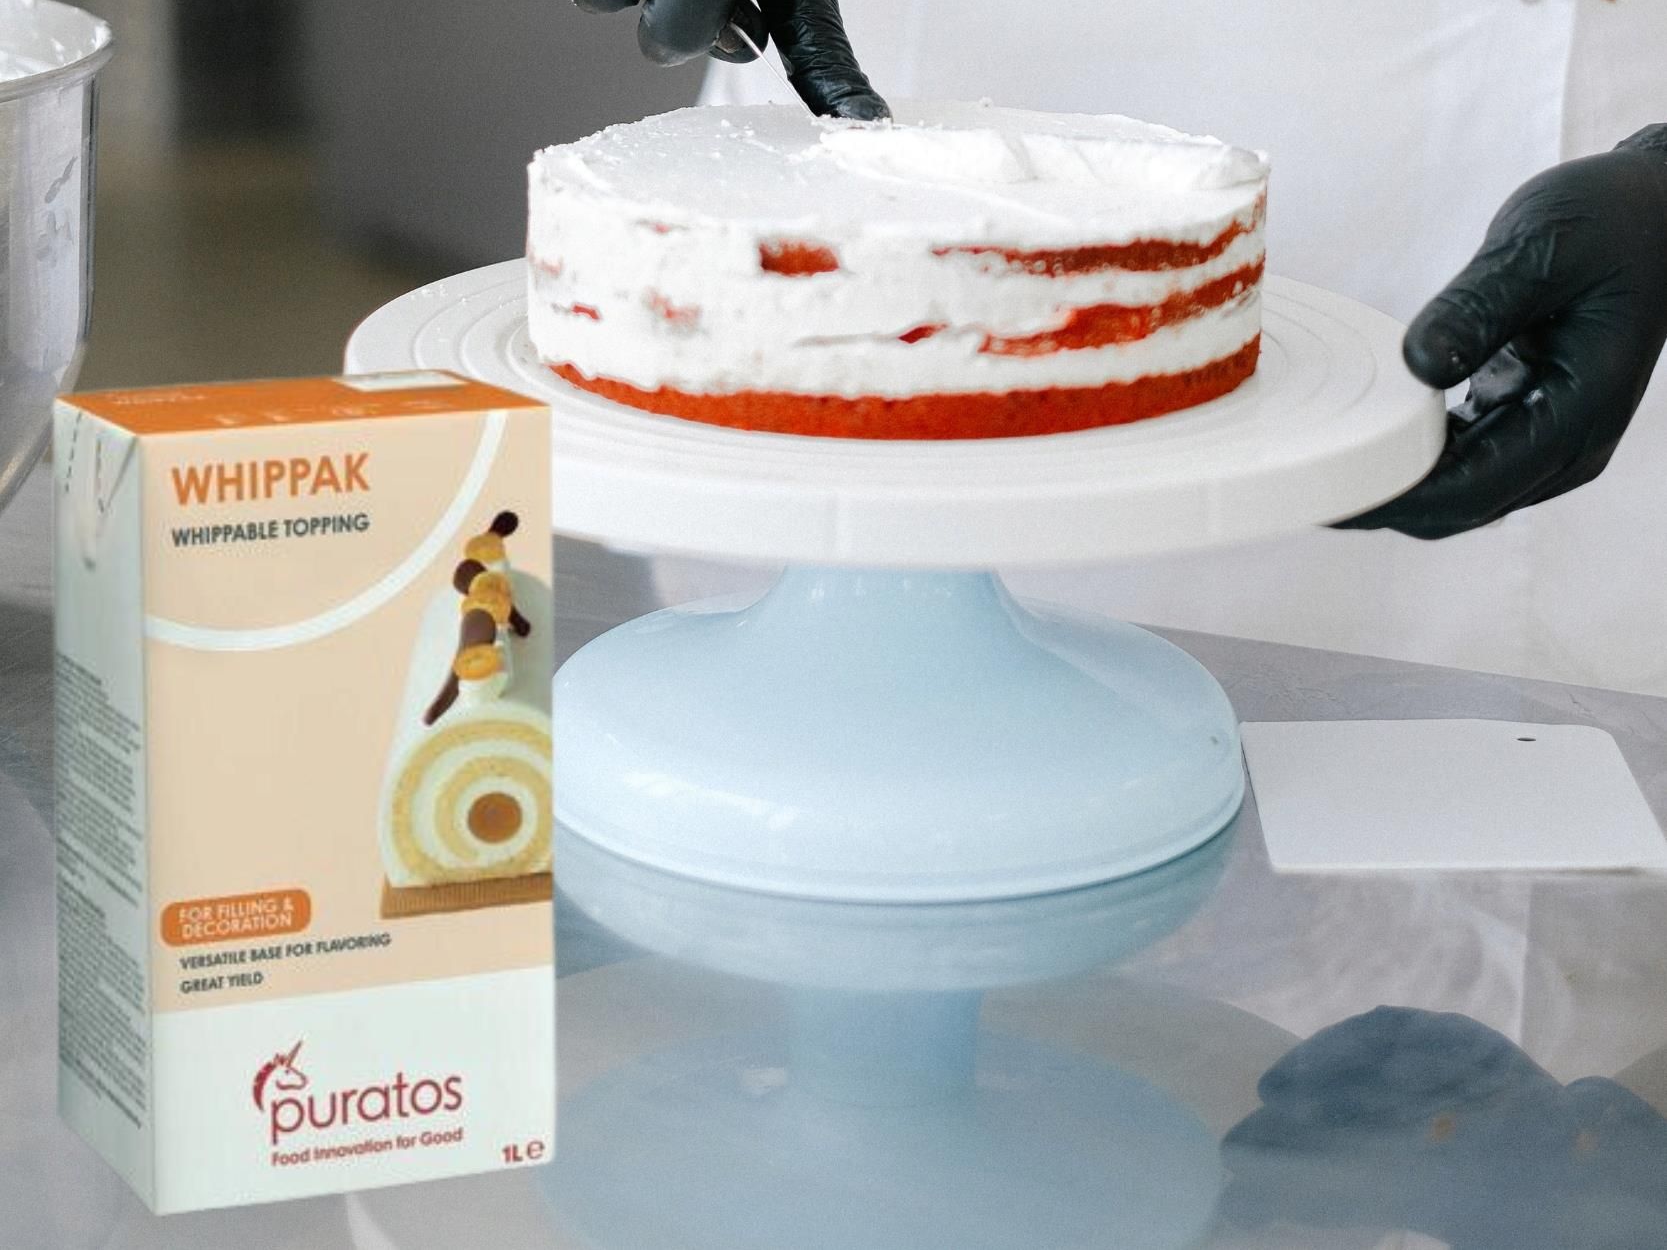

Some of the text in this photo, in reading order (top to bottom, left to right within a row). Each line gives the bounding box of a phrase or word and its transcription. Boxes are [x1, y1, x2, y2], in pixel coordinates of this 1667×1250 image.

[171, 452, 370, 505] WHIPPAK
[171, 513, 371, 547] WHIPPABLE TOPPING
[179, 897, 294, 924] FOR FILLING &
[181, 913, 292, 938] DECORATION
[179, 932, 392, 970] VERSATILE BASE FOR FLAVORING
[180, 971, 264, 994] GREAT YIELD
[270, 1071, 462, 1146] puratos
[272, 1127, 463, 1166] Food Innovation for Good
[502, 1143, 523, 1163] 1L
